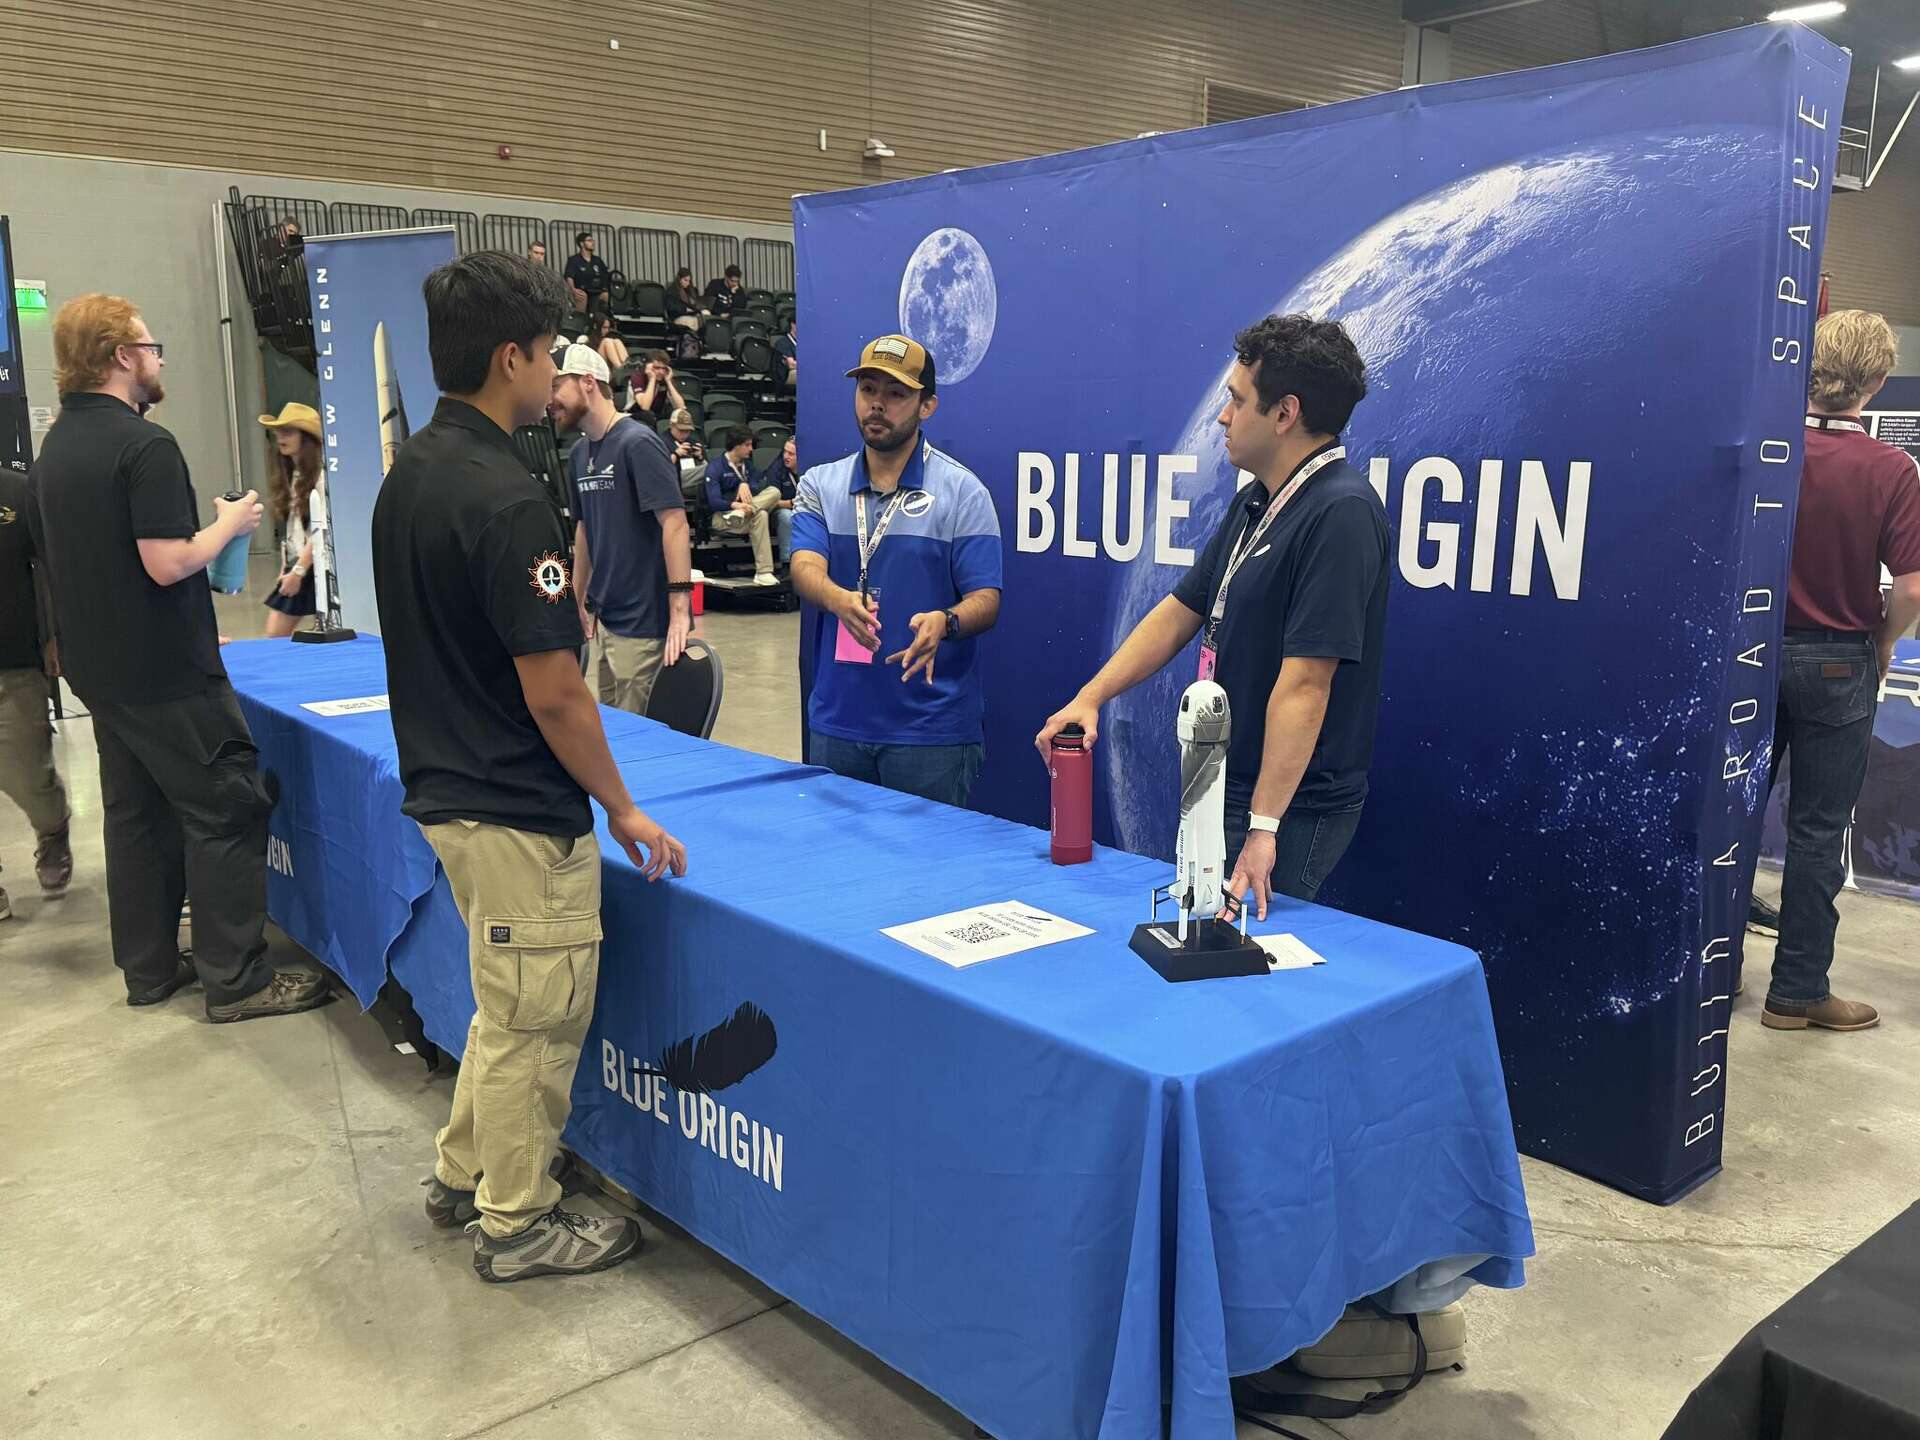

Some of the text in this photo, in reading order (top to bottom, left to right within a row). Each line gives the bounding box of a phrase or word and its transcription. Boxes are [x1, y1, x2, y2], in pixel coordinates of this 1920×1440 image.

[1772, 95, 1828, 365] SPACE
[316, 268, 339, 472] NEW GLENN
[1017, 452, 1197, 567] BLUE
[1753, 439, 1790, 517] TO
[1722, 588, 1773, 780] ROAD
[266, 833, 295, 878] IGIN
[1712, 841, 1739, 867] A
[602, 1038, 784, 1192] BLUE ORIGIN
